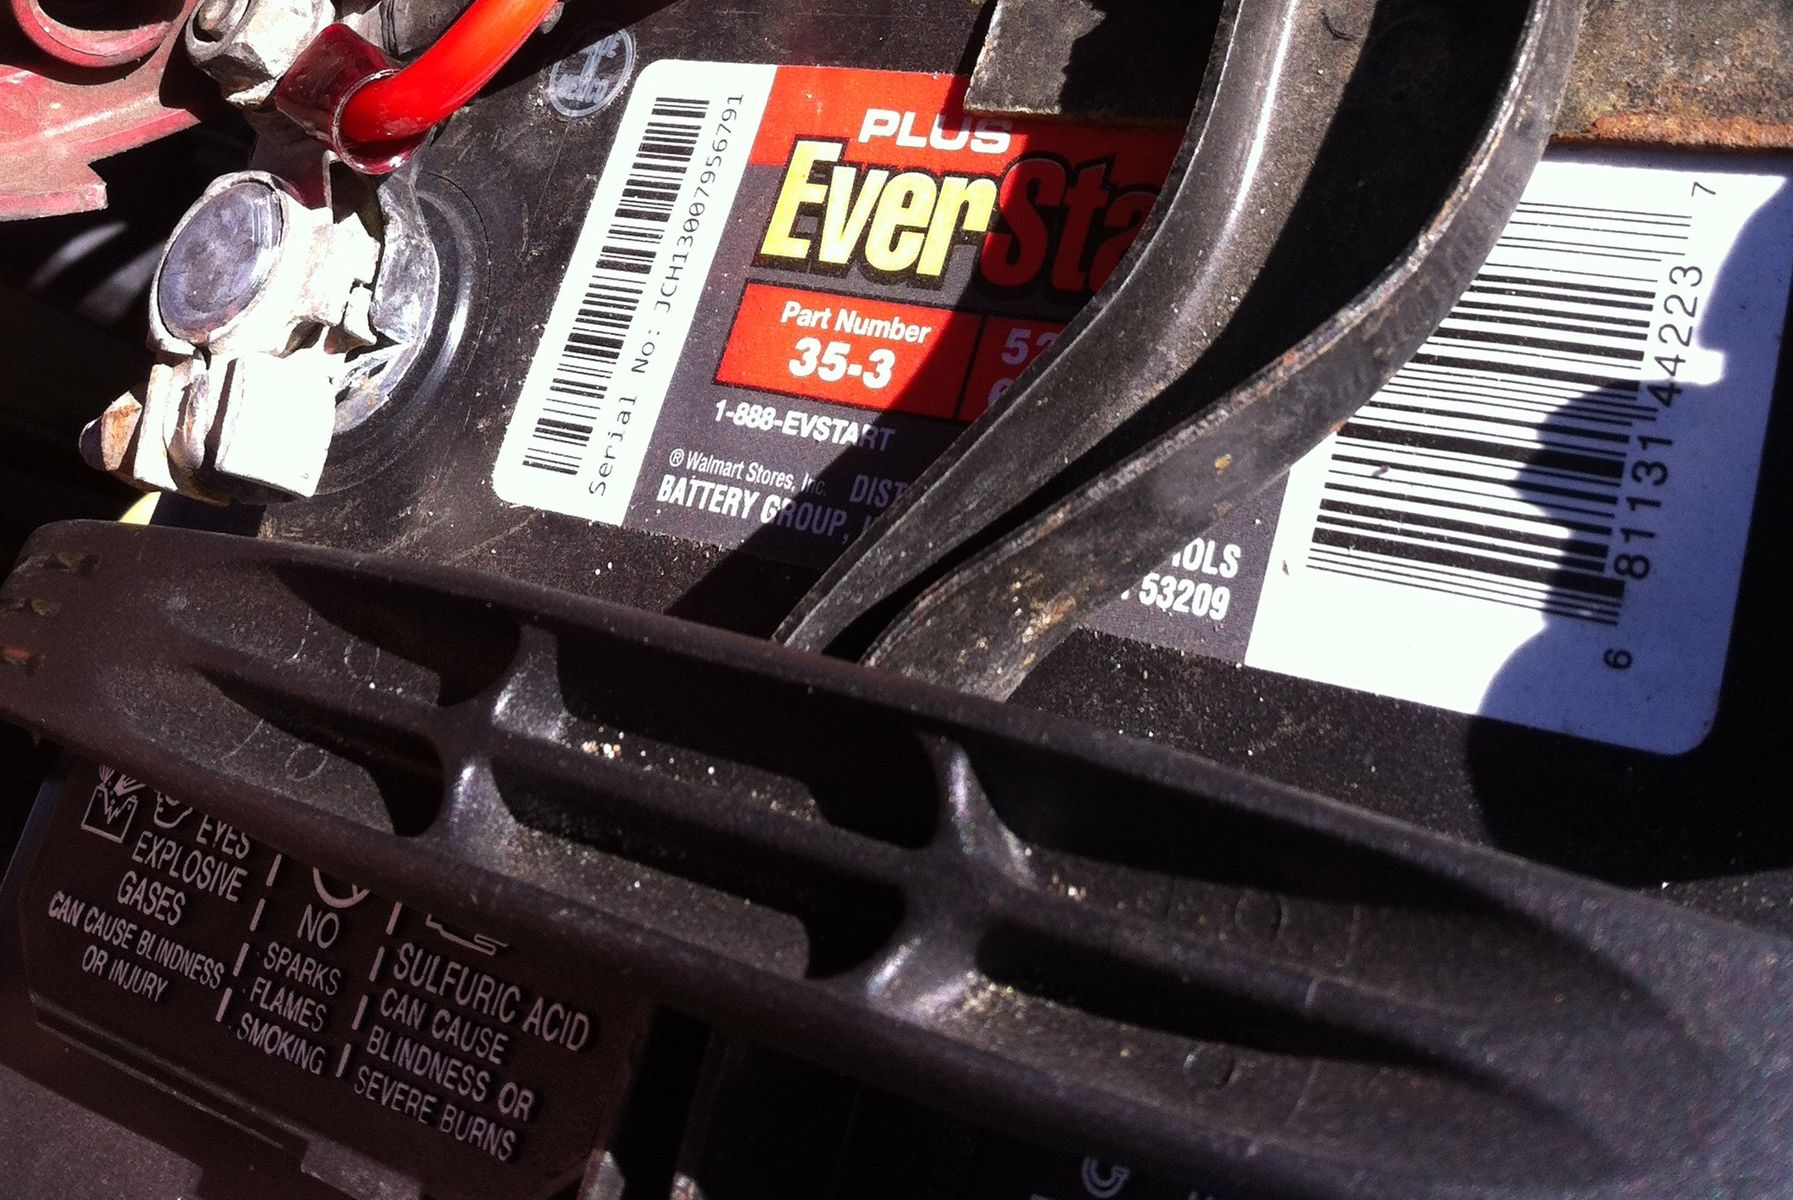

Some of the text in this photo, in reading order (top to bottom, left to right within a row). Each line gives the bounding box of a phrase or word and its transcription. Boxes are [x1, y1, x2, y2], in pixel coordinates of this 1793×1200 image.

[857, 108, 1014, 154] PLUS
[760, 139, 1160, 295] EverSta
[588, 94, 744, 497] Serial No: JCH13007956791
[780, 301, 931, 344] Part Number
[789, 336, 896, 389] 35-3
[714, 399, 896, 451] 1-888-EVSTART
[686, 450, 744, 480] Walmart
[746, 461, 796, 492] Stores,
[656, 474, 760, 519] BATTERY
[760, 495, 850, 544] GROUP,
[1138, 572, 1231, 621] 53209
[196, 814, 250, 860] EYES
[131, 830, 249, 903] EXPLOSIVE
[116, 870, 186, 927] GASES
[297, 903, 341, 949] NO
[48, 890, 225, 990] CAN CAUSE BLINDNESS
[263, 940, 342, 996] SPARKS
[82, 944, 168, 1002] OR INJURY
[392, 941, 592, 1052] SULFURIC ACID
[249, 976, 328, 1033] FLAMES
[379, 987, 510, 1065] CAN CAUSE
[236, 1011, 327, 1076] SMOKING
[366, 1025, 536, 1122] BLINDNESS OR
[353, 1065, 518, 1162] SEVERE BURNS
